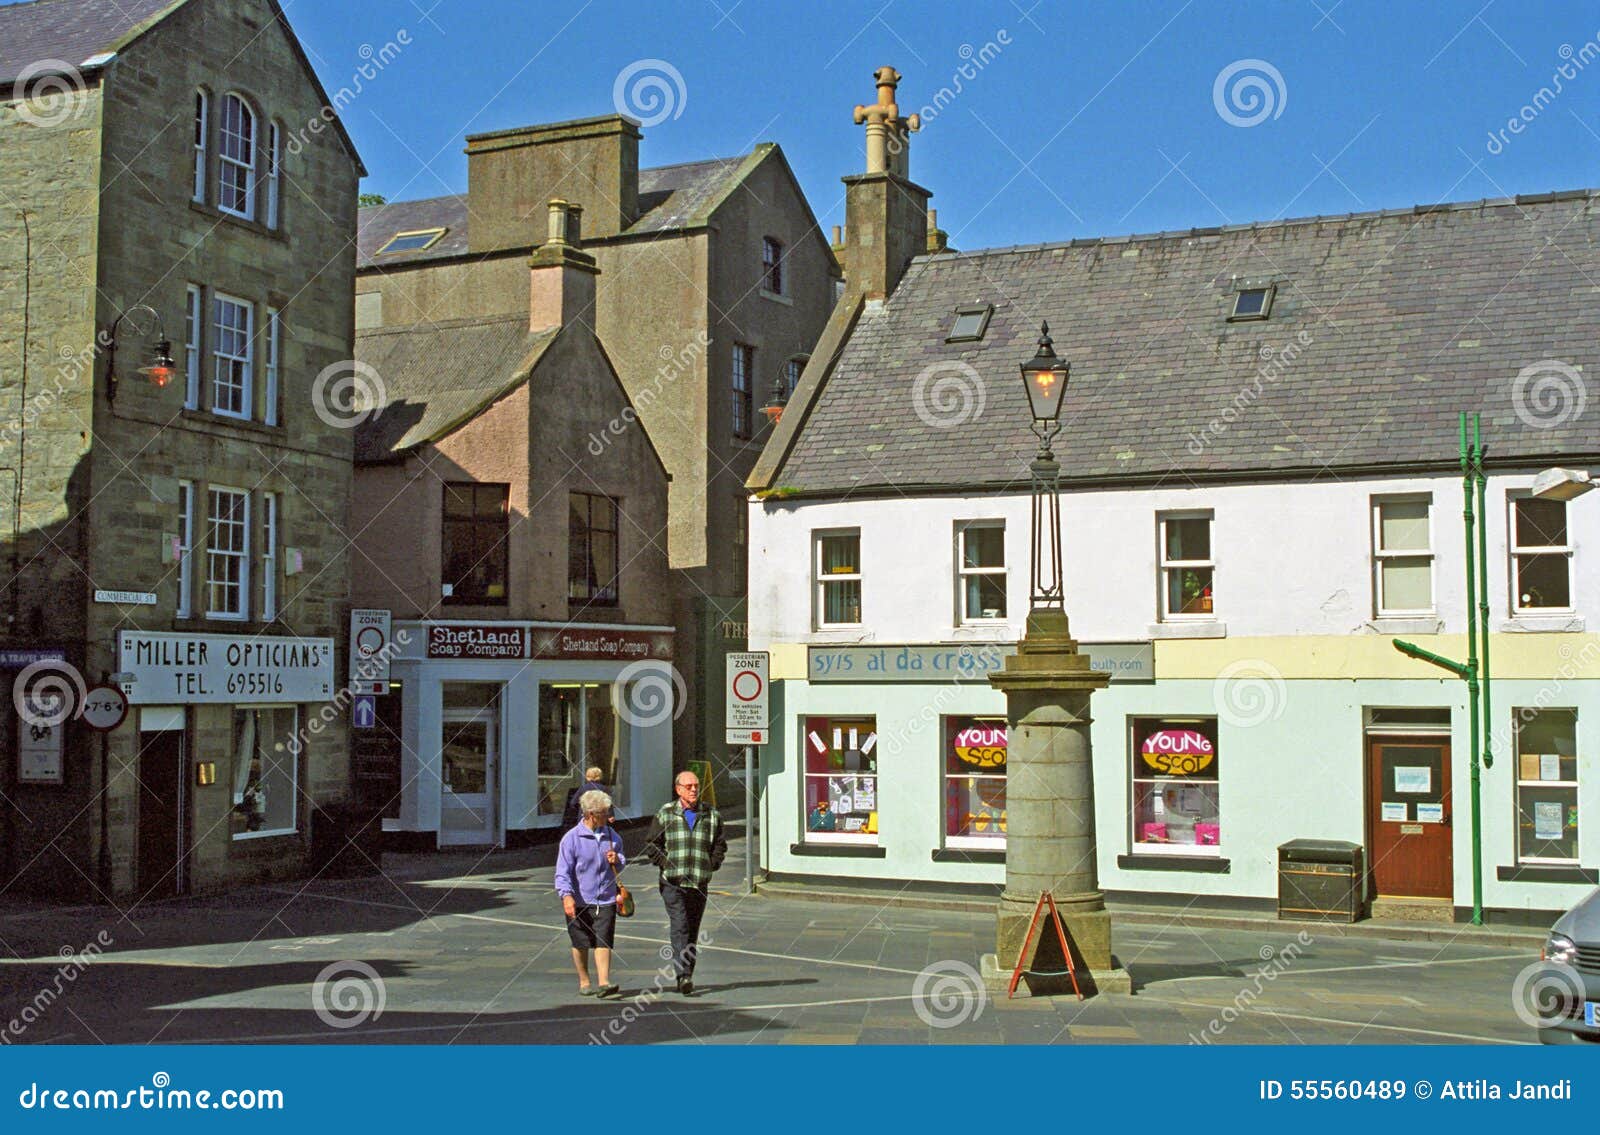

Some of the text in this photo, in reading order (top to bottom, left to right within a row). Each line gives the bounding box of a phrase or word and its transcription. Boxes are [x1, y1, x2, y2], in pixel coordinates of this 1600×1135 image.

[97, 590, 142, 602] COMMERCIAL
[359, 617, 384, 625] ZONE
[433, 627, 521, 645] Shetland
[136, 640, 321, 668] MILLER OPTICIANS
[430, 642, 523, 657] Soap Company
[562, 635, 650, 657] Shetland Soap Company
[734, 660, 761, 668] ZONE
[866, 650, 887, 673] at
[896, 648, 923, 671] da
[932, 652, 1001, 671] cross
[175, 673, 283, 694] TEL. 695516
[958, 729, 1007, 747] YOUN
[1145, 731, 1212, 754] YOUNG
[1155, 753, 1205, 774] SCOT
